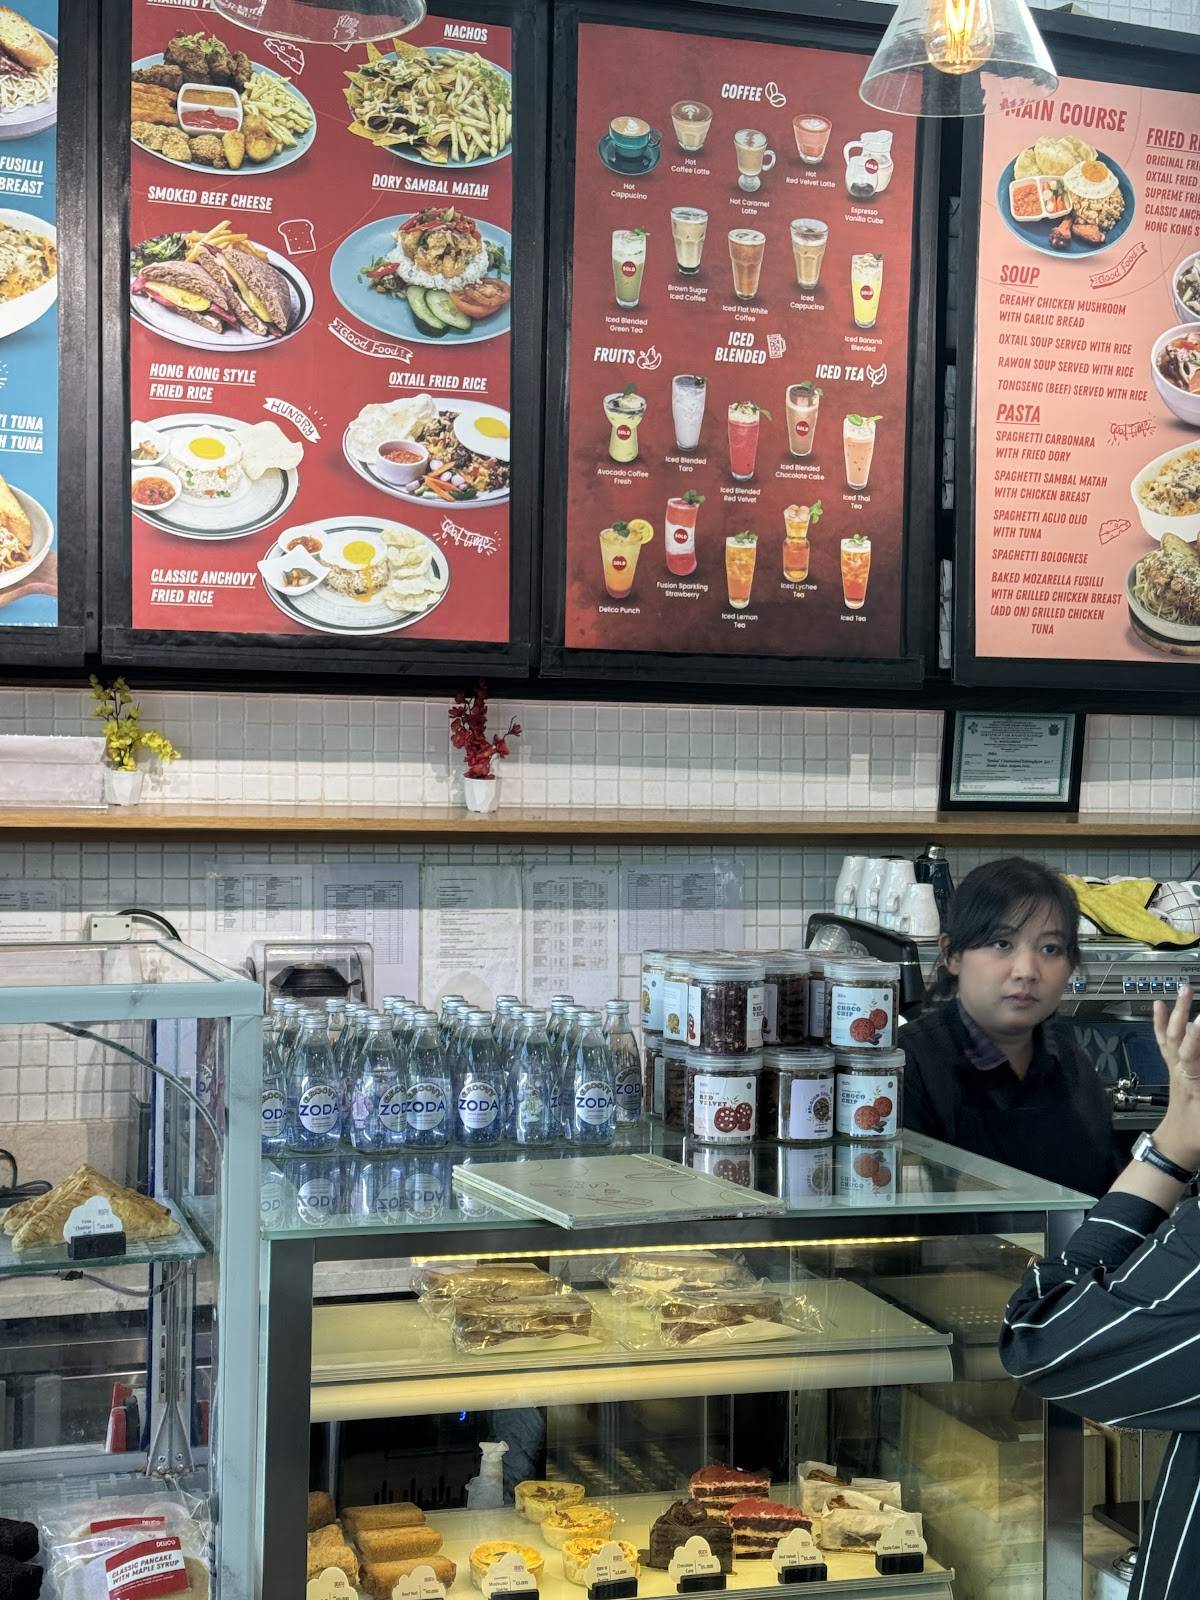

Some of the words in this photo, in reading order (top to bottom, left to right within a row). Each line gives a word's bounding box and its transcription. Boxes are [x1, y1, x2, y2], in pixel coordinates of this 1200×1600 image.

[444, 24, 488, 41] NACHOS
[721, 83, 762, 101] COFFEE
[1060, 102, 1128, 132] COURSE
[1146, 128, 1184, 148] FRIED
[0, 156, 44, 174] FUSILLI
[1146, 154, 1184, 169] ORIGINAL
[671, 166, 692, 174] Coffee
[0, 177, 44, 194] BREAST
[372, 174, 402, 190] DORY
[404, 177, 448, 194] SAMBAL
[452, 180, 489, 197] MATAH
[1146, 170, 1173, 183] OXTAIL
[1175, 174, 1198, 187] FRIED
[148, 186, 197, 204] SMOKED
[200, 191, 228, 207] BEEF
[231, 194, 272, 210] CHEESE
[610, 190, 648, 200] Cappucino
[1145, 187, 1182, 201] SUPREME
[743, 200, 770, 208] Caramel
[850, 207, 878, 216] Espresso
[1145, 204, 1177, 217] CLASSIC
[845, 214, 866, 222] Vanilla
[1145, 220, 1168, 232] HONG
[1170, 224, 1193, 236] KONG
[1000, 264, 1040, 284] SOUP
[668, 284, 687, 293] Brown
[689, 286, 708, 296] Sugar
[670, 292, 684, 300] Iced
[686, 294, 706, 302] Coffee
[751, 306, 768, 314] White
[790, 302, 824, 311] Cappucino
[1000, 294, 1035, 307] CREAMY
[1037, 296, 1074, 310] CHICKEN
[1078, 301, 1126, 315] MUSHROOM
[621, 317, 648, 326] Blended
[734, 314, 756, 322] Coffee
[1000, 311, 1022, 322] WITH
[1024, 313, 1054, 325] GARLIC
[1056, 316, 1085, 328] BREAD
[339, 328, 367, 350] Good
[728, 332, 754, 346] ICED
[999, 334, 1028, 346] OXTAIL
[1030, 336, 1053, 348] SOUP
[1055, 338, 1087, 351] SERVED
[1090, 342, 1111, 353] WITH
[1114, 344, 1132, 355] RICE
[594, 347, 636, 364] FRUITS
[715, 347, 766, 364] BLENDED
[150, 364, 184, 378] HONG
[187, 366, 220, 380] KONG
[223, 368, 256, 383] STYLE
[816, 364, 841, 379] ICED
[844, 366, 864, 381] TEA
[998, 357, 1031, 369] RAWON
[1034, 359, 1056, 371] SOUP
[1058, 361, 1089, 374] SERVED
[1092, 365, 1114, 376] WITH
[1116, 366, 1134, 377] RICE
[389, 372, 426, 386] OXTAIL
[429, 375, 460, 389] FRIED
[462, 377, 488, 390] RICE
[150, 384, 184, 398] FRIED
[187, 386, 213, 400] RICE
[998, 380, 1044, 393] TONGSENG
[1046, 384, 1071, 395] (BEEF)
[1074, 385, 1104, 398] SERVED
[1107, 388, 1128, 399] WITH
[1130, 390, 1148, 401] RICE
[271, 400, 314, 436] HUNGRY
[996, 404, 1040, 423] PASTA
[10, 415, 44, 430] TUNA
[10, 436, 44, 450] TUNA
[996, 431, 1043, 444] SPAGHETTI
[1045, 434, 1095, 447] CARBONARA
[680, 456, 706, 464] Blended
[996, 448, 1019, 459] WITH
[1022, 449, 1046, 460] FRIED
[1048, 451, 1071, 462] DORY
[598, 469, 626, 477] Avocado
[628, 470, 649, 478] Coffee
[775, 471, 805, 479] Chocolate
[795, 464, 820, 472] Blended
[614, 478, 632, 486] Fresh
[995, 470, 1042, 484] SPAGHETTI
[1044, 473, 1076, 485] SAMBAL
[1080, 476, 1107, 488] MATAH
[735, 488, 760, 496] Blended
[994, 487, 1018, 498] WITH
[1020, 489, 1058, 501] CHICKEN
[1060, 491, 1091, 503] BREAST
[993, 510, 1040, 523] SPAGHETTI
[1042, 513, 1066, 524] AGLIO
[1068, 514, 1088, 525] OLIO
[993, 527, 1016, 538] WITH
[1019, 528, 1042, 539] TUNA
[992, 549, 1038, 562] SPAGHETTI
[1041, 552, 1088, 564] BOLOGNESE
[150, 569, 198, 584] CLASSIC
[200, 571, 256, 586] ANCHOVY
[992, 572, 1021, 584] BAKED
[1023, 574, 1071, 585] MOZARELLA
[1073, 576, 1104, 588] FUSILLI
[657, 582, 677, 590] Fusion
[678, 583, 708, 592] Sparkling
[795, 584, 817, 592] Lychee
[151, 589, 184, 604] FRIED
[188, 591, 214, 604] RICE
[665, 590, 700, 600] Strawberry
[992, 589, 1013, 600] WITH
[1015, 590, 1050, 601] GRILLED
[1052, 592, 1089, 603] CHICKEN
[1090, 594, 1122, 605] BREAST
[991, 606, 1011, 617] (ADD
[1014, 607, 1030, 618] ON)
[1032, 607, 1066, 619] GRILLED
[1068, 608, 1104, 620] CHICKEN
[1032, 624, 1054, 635] TUNA
[300, 1104, 340, 1116] ZODA
[406, 1101, 445, 1114] ZODA
[458, 1099, 499, 1111] ZODA
[576, 1097, 614, 1108] ZODA
[112, 1562, 138, 1578] CLASSIC
[140, 1554, 172, 1566] PANCAKE
[113, 1573, 130, 1584] WITH
[132, 1565, 154, 1576] MAPLE
[156, 1560, 179, 1569] SYRUP
